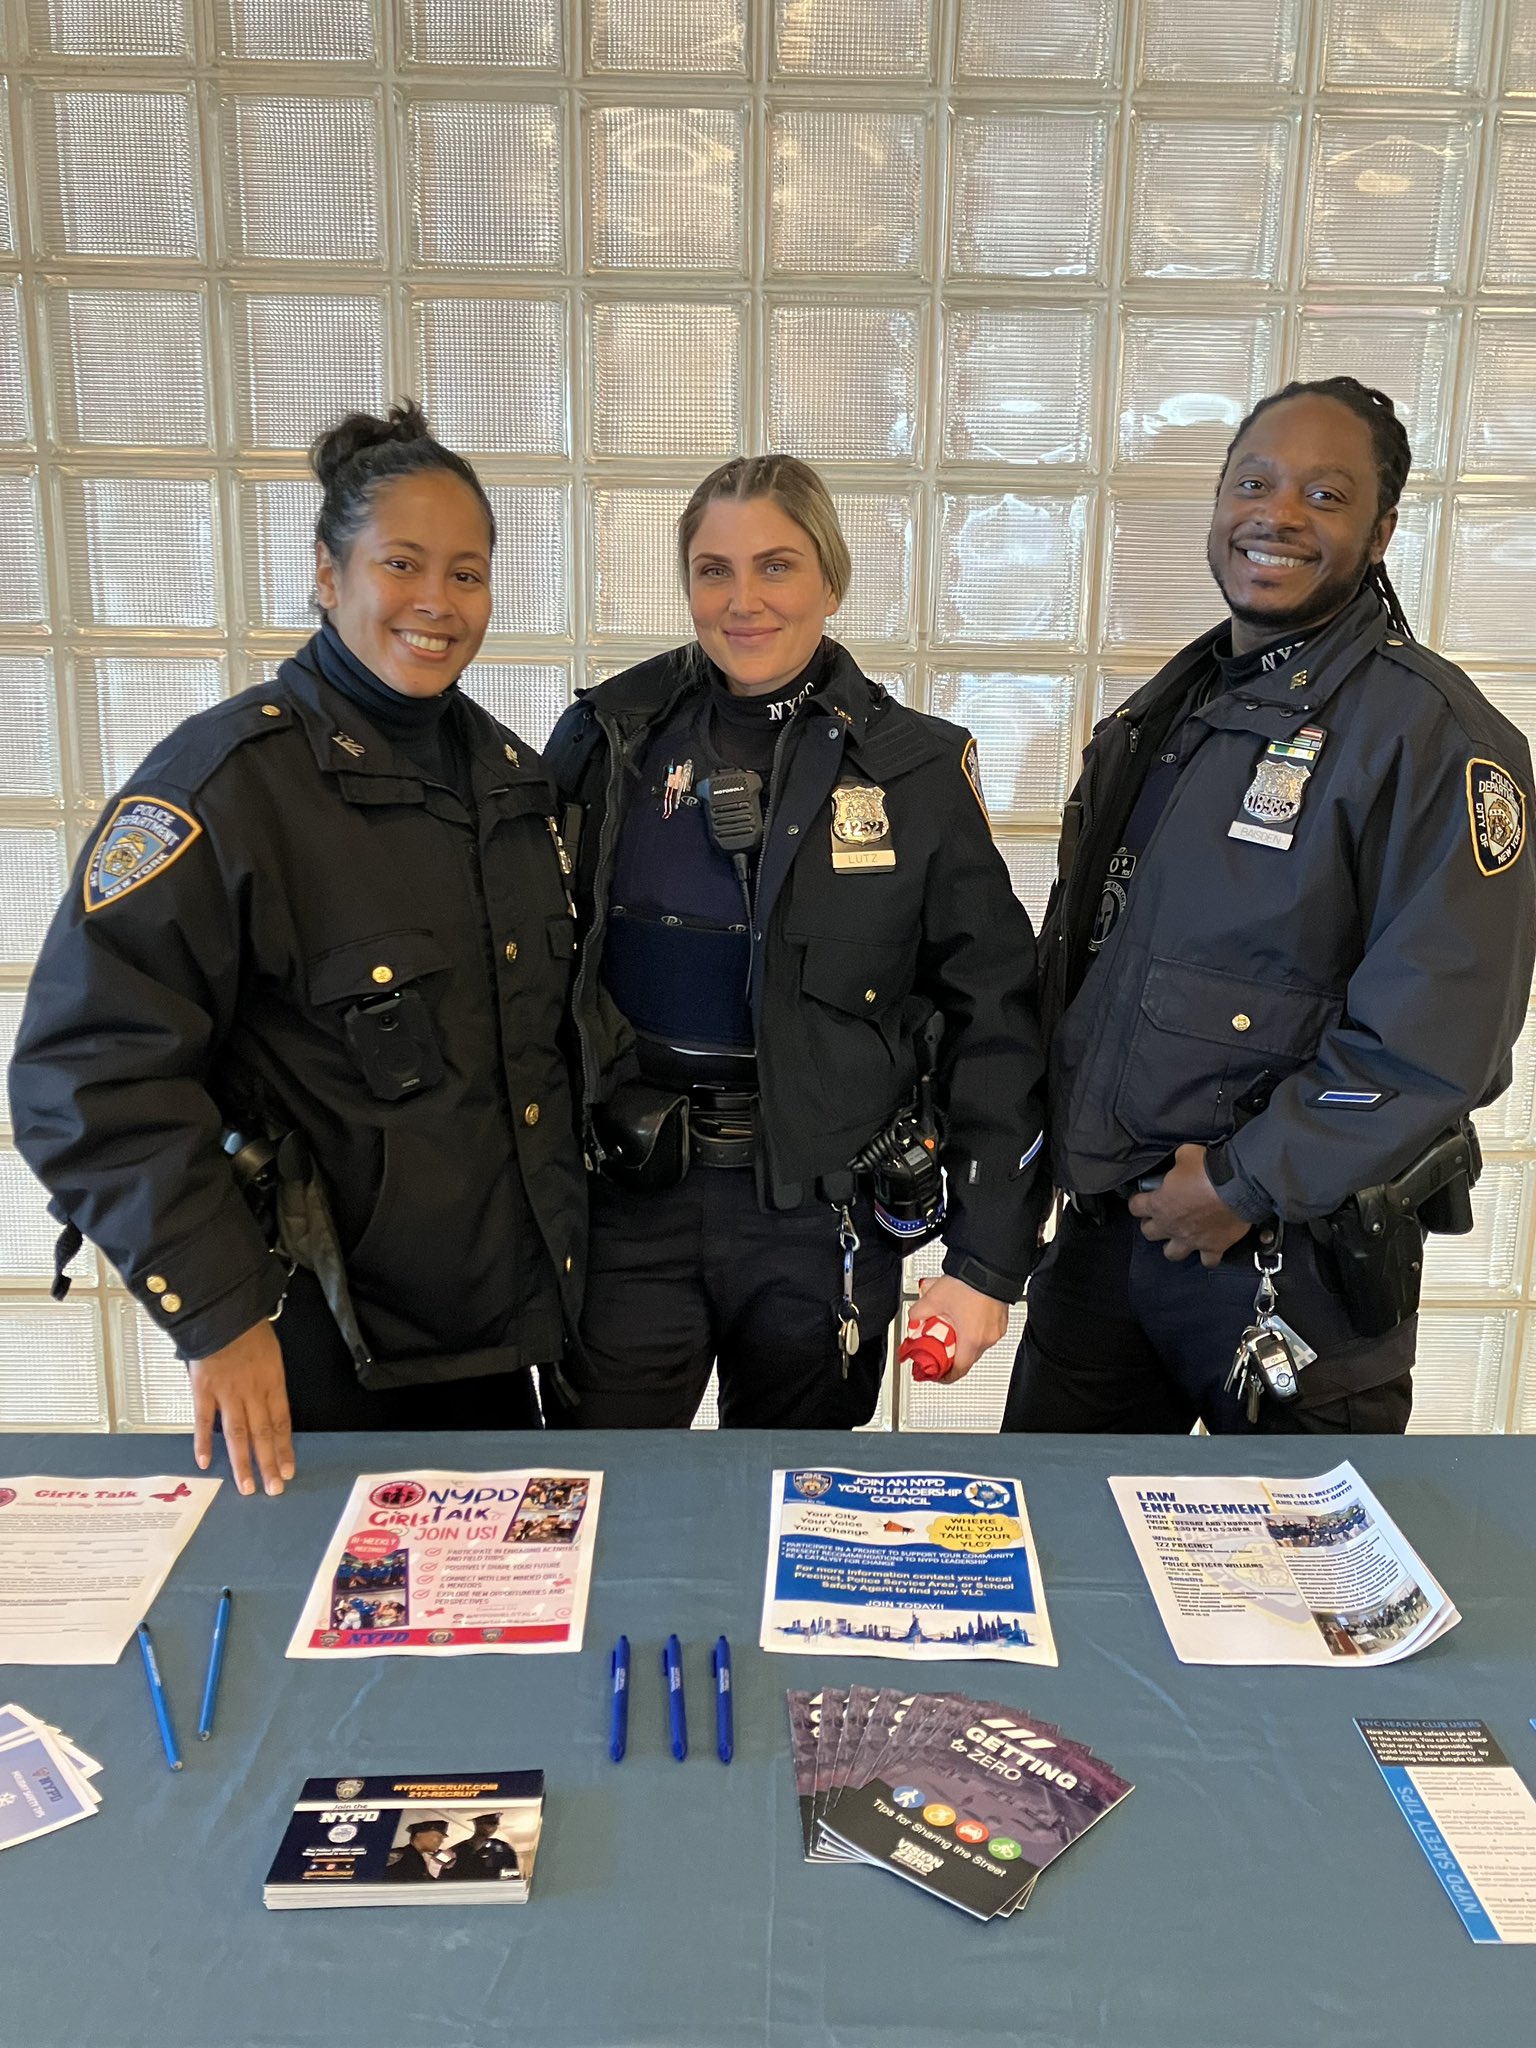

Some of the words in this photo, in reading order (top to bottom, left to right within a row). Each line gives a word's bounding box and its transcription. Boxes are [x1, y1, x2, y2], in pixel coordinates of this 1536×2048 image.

[132, 805, 176, 826] POLICE
[1476, 803, 1485, 827] CITY
[113, 815, 179, 846] DEPARTMENT
[1480, 833, 1488, 848] OF
[848, 854, 877, 863] LUTZ
[1498, 848, 1511, 864] NEW
[132, 852, 171, 879] YORK
[853, 1478, 884, 1486] JOIN
[887, 1479, 907, 1487] AN
[910, 1479, 945, 1487] NYPD
[1315, 1480, 1347, 1497] MEETING
[35, 1489, 88, 1498] Girl's
[95, 1490, 139, 1498] Talk
[427, 1488, 519, 1504] NYPD
[838, 1484, 884, 1494] YOUTH
[886, 1487, 962, 1497] LEADERSHIP
[1136, 1491, 1176, 1502] LAW
[870, 1495, 931, 1505] COUNCIL
[1140, 1502, 1271, 1514] ENFORCEMENT
[800, 1517, 825, 1525] Your
[830, 1519, 862, 1527] Voice
[414, 1527, 459, 1541] JOIN
[467, 1526, 498, 1540] US!
[823, 1527, 869, 1536] Change
[787, 1542, 833, 1550] PARTICIPATE
[853, 1546, 886, 1555] PROJECT
[805, 1554, 842, 1563] CATALYST
[822, 1551, 903, 1562] RECOMMENDATIONS
[817, 1567, 845, 1575] more
[822, 1581, 857, 1591] Safety
[860, 1585, 893, 1593] Agent
[847, 1576, 880, 1584] Police
[884, 1578, 926, 1587] Service
[951, 1739, 968, 1752] to
[967, 1748, 1021, 1781] ZERO
[966, 1727, 1077, 1790] GETTING
[1397, 1786, 1425, 1815] TIPS
[319, 1811, 380, 1823] NYPD
[873, 1798, 895, 1817] Tips
[896, 1814, 912, 1826] for
[912, 1823, 952, 1850] Sharing
[953, 1845, 971, 1859] the
[972, 1856, 1006, 1878] Street
[1413, 1819, 1456, 1869] SAFETY
[897, 1838, 944, 1869] VISION
[890, 1850, 934, 1873] ZERO
[1446, 1875, 1481, 1913] NYPD
